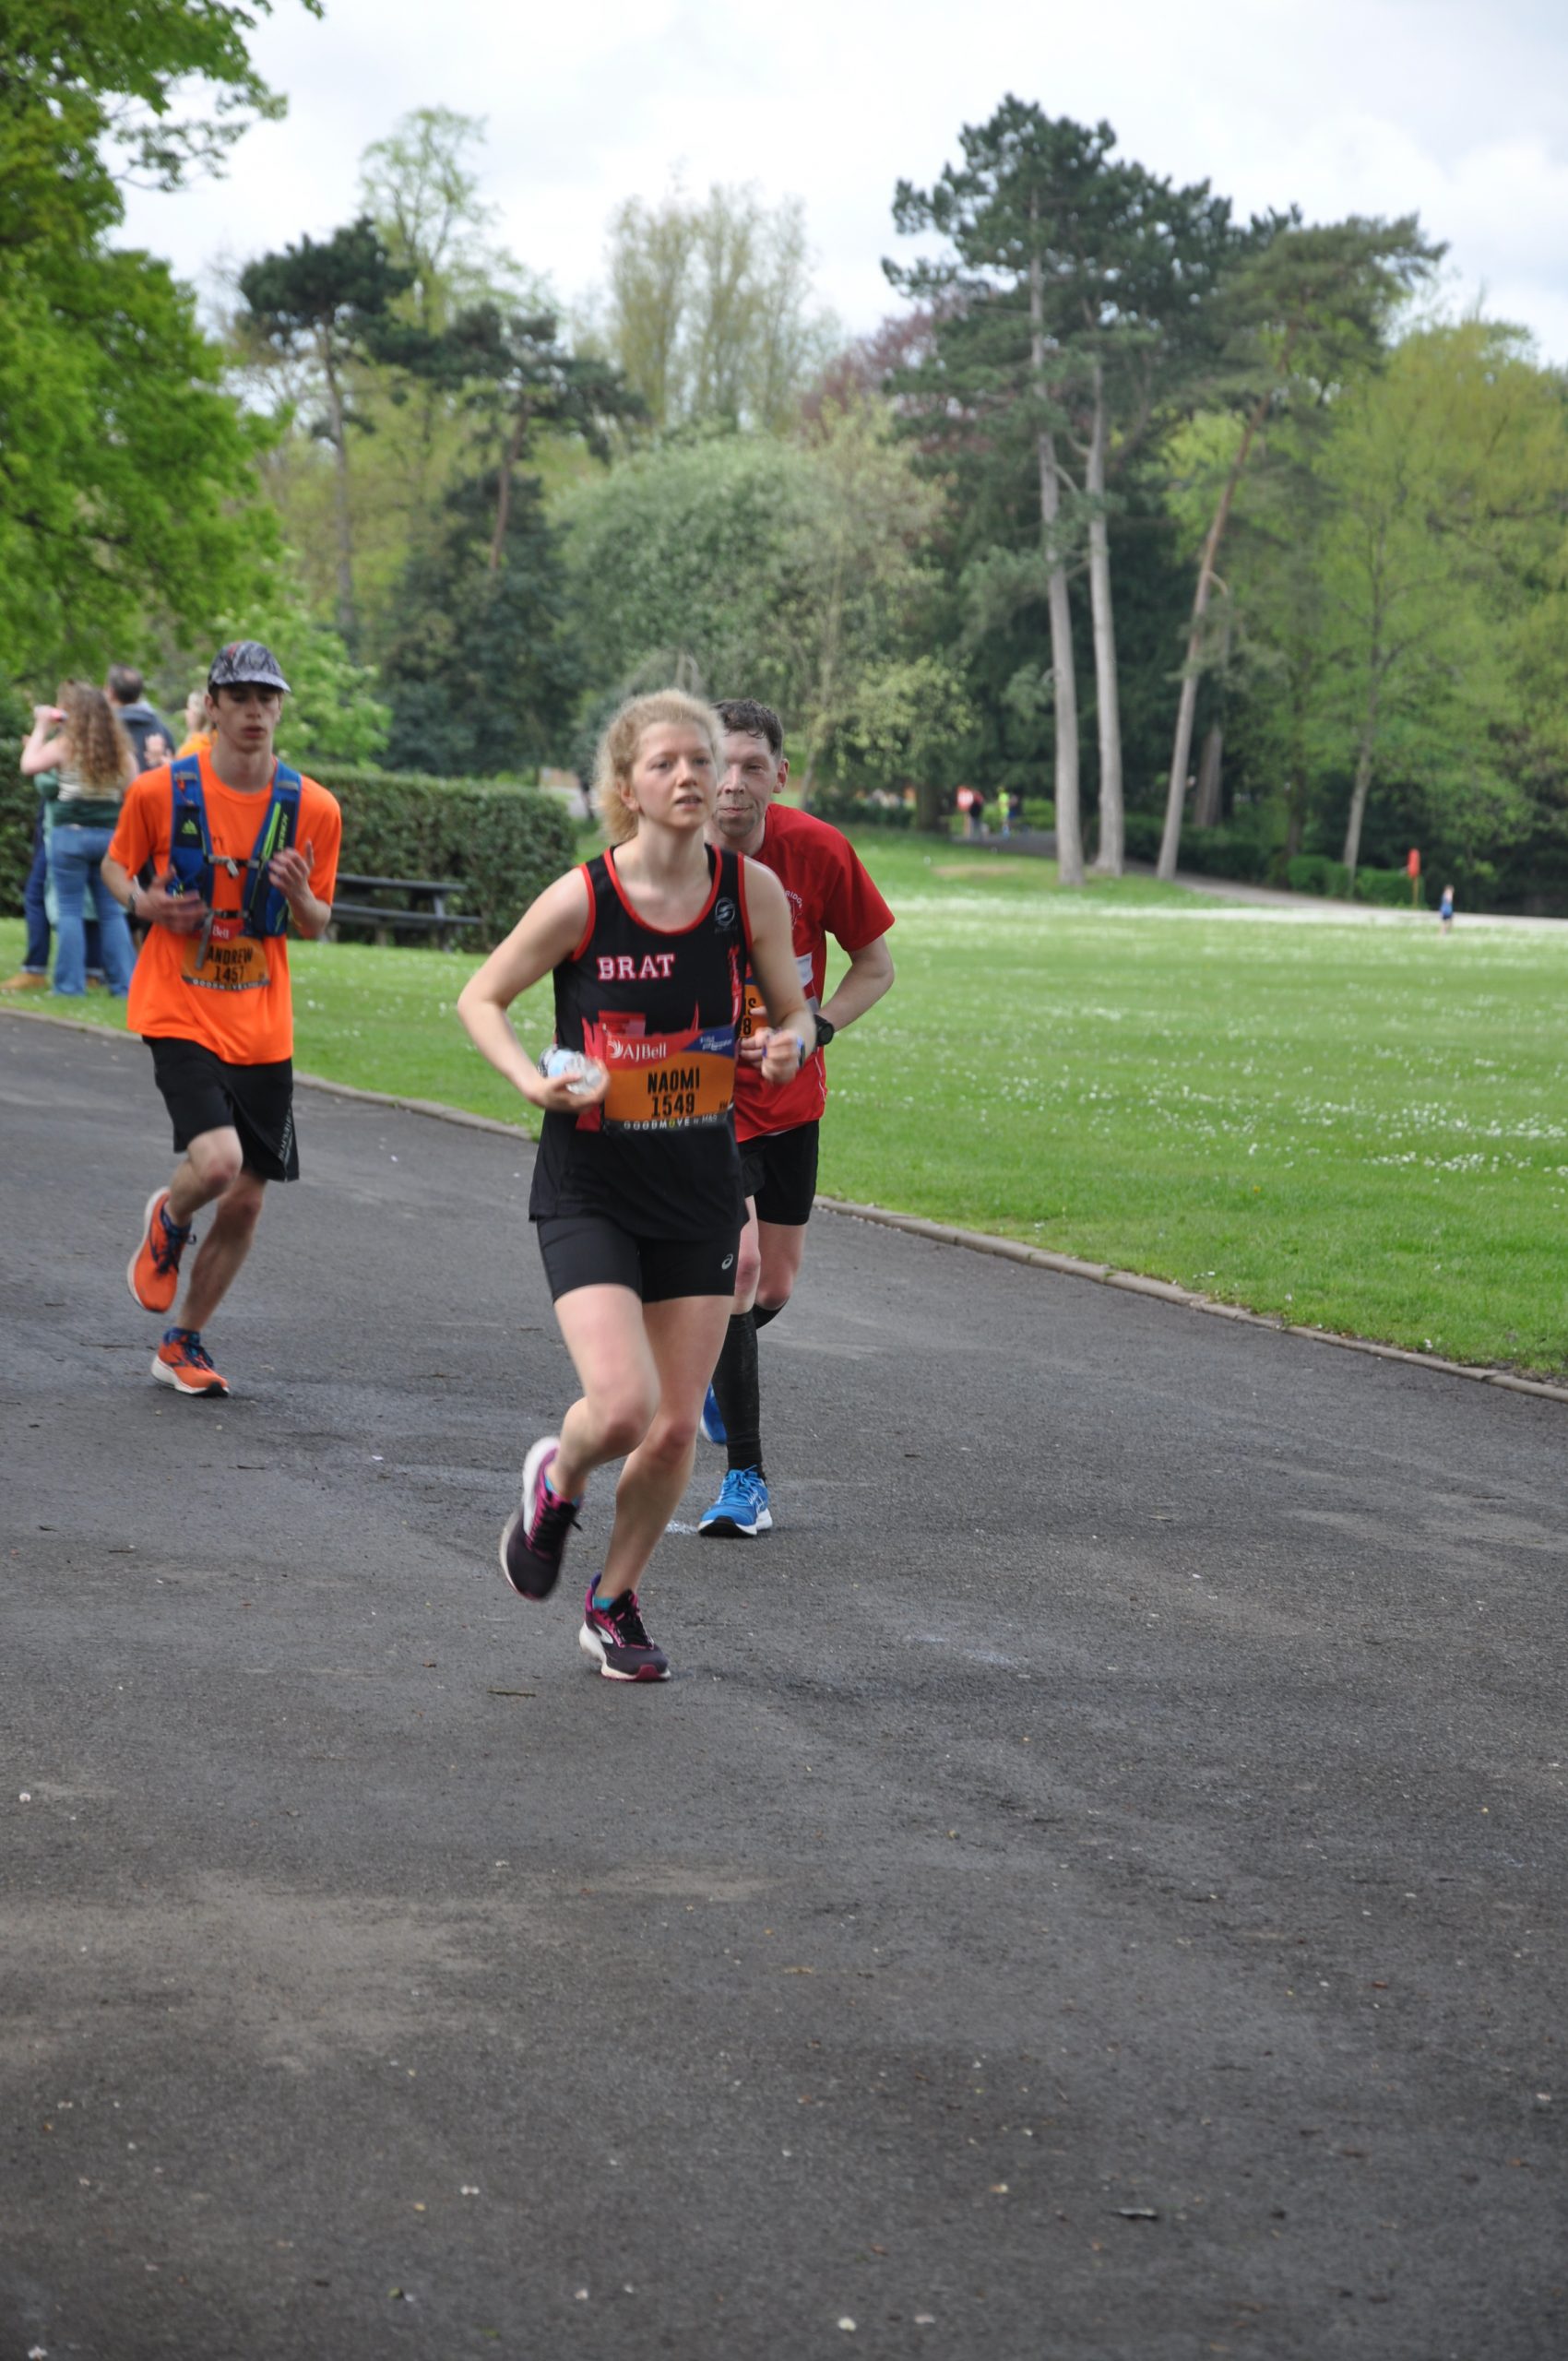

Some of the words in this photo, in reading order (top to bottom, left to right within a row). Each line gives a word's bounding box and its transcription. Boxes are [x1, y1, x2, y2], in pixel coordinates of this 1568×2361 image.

[207, 944, 253, 965] ANDREW
[596, 952, 675, 981] BRAT
[647, 1065, 700, 1094] NAOMI
